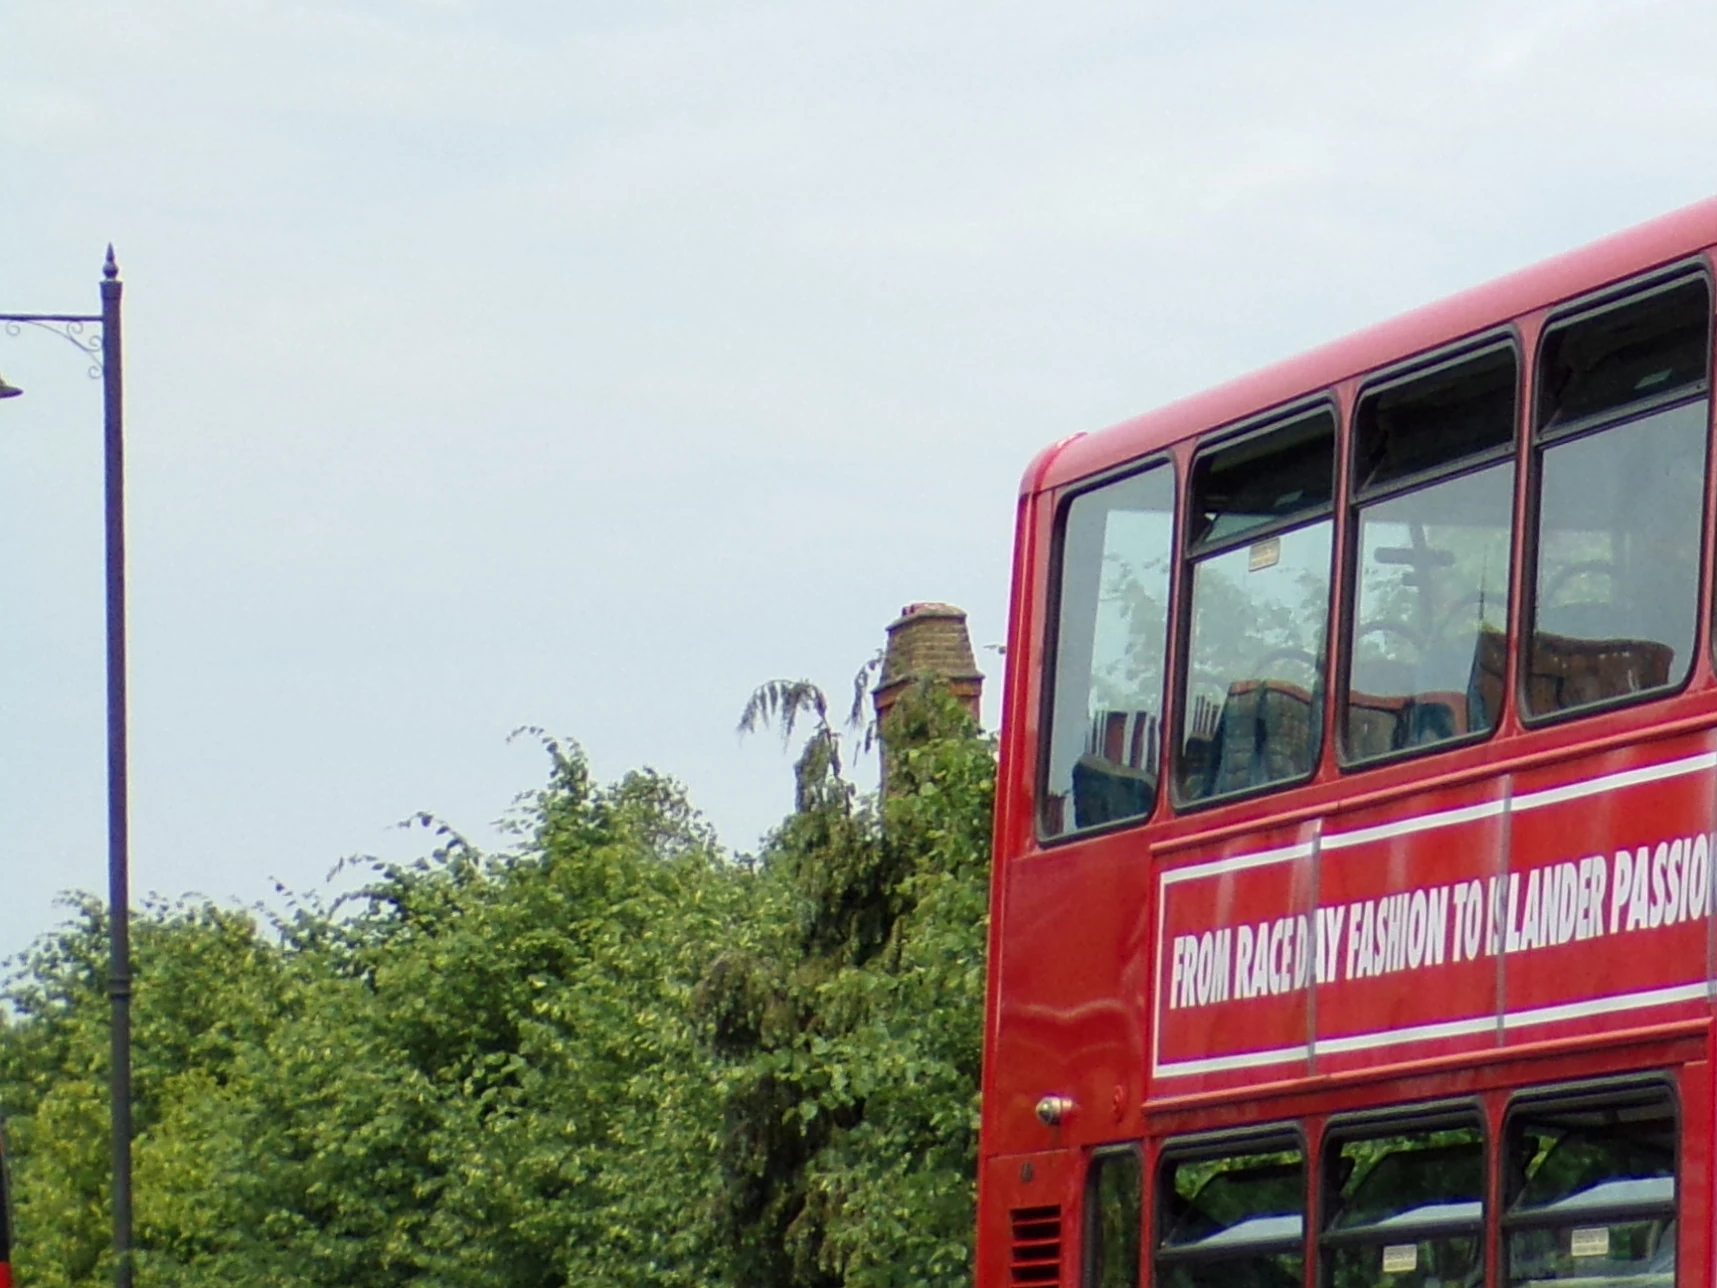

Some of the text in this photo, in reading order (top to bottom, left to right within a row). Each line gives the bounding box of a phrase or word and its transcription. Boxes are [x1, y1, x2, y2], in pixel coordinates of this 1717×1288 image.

[1170, 927, 1230, 1009] FROM
[1345, 886, 1449, 980] FASHION
[1452, 880, 1483, 963] TO
[1485, 855, 1607, 957] ISLANDER
